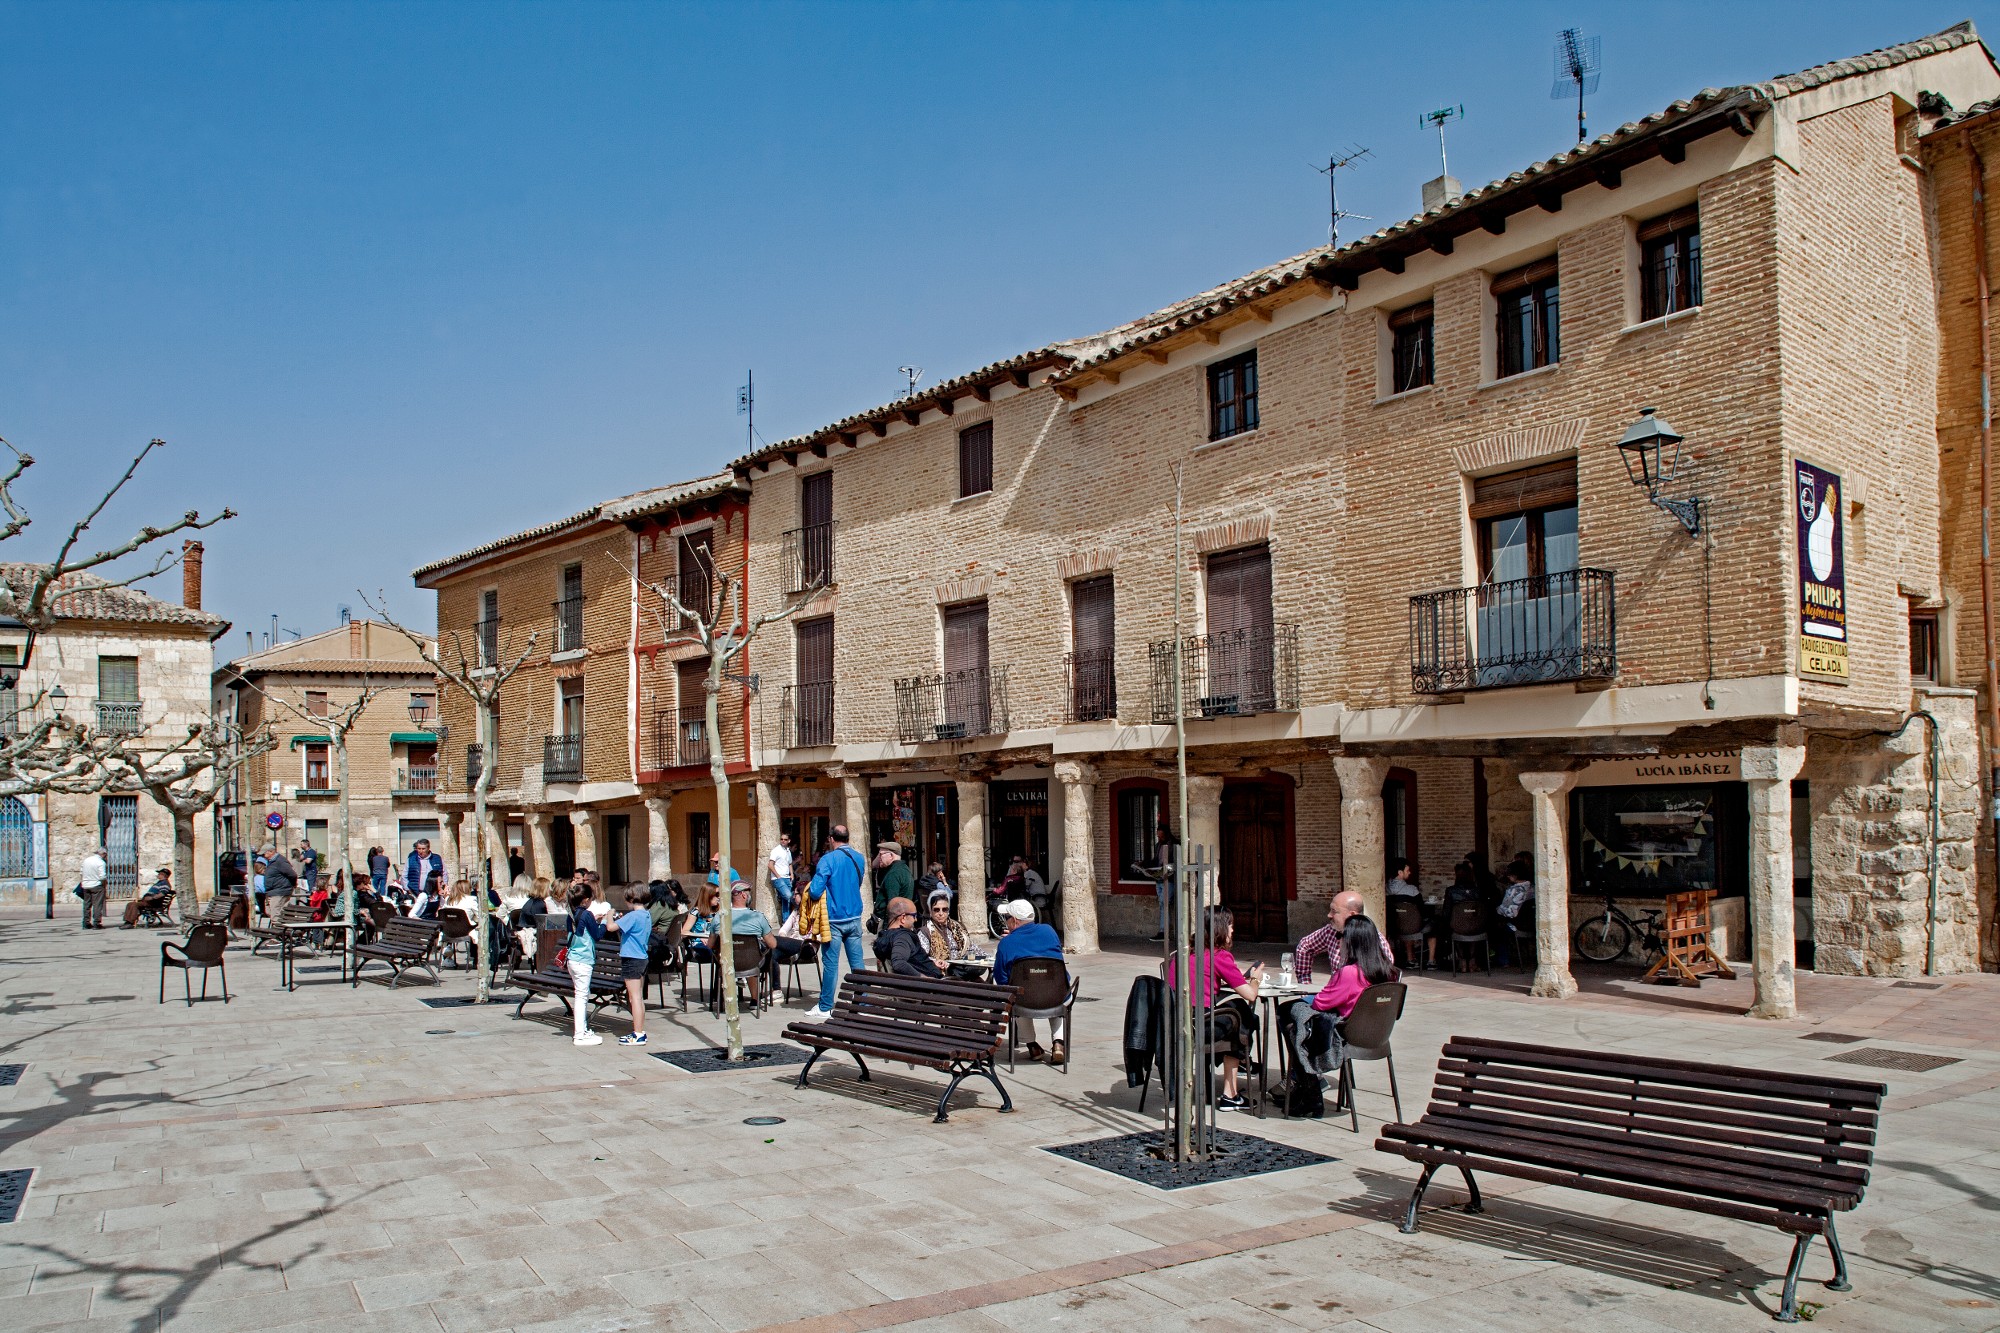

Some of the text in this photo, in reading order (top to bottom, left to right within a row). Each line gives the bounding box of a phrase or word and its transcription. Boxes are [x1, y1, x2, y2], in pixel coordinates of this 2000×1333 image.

[1805, 581, 1841, 609] PHILIPS
[1801, 637, 1848, 657] RADIOELECTRICIDAD
[1809, 657, 1842, 674] CELADA
[1636, 763, 1731, 777] LUCÍA IBÁÑEZ
[1007, 791, 1048, 801] CENTRAL
